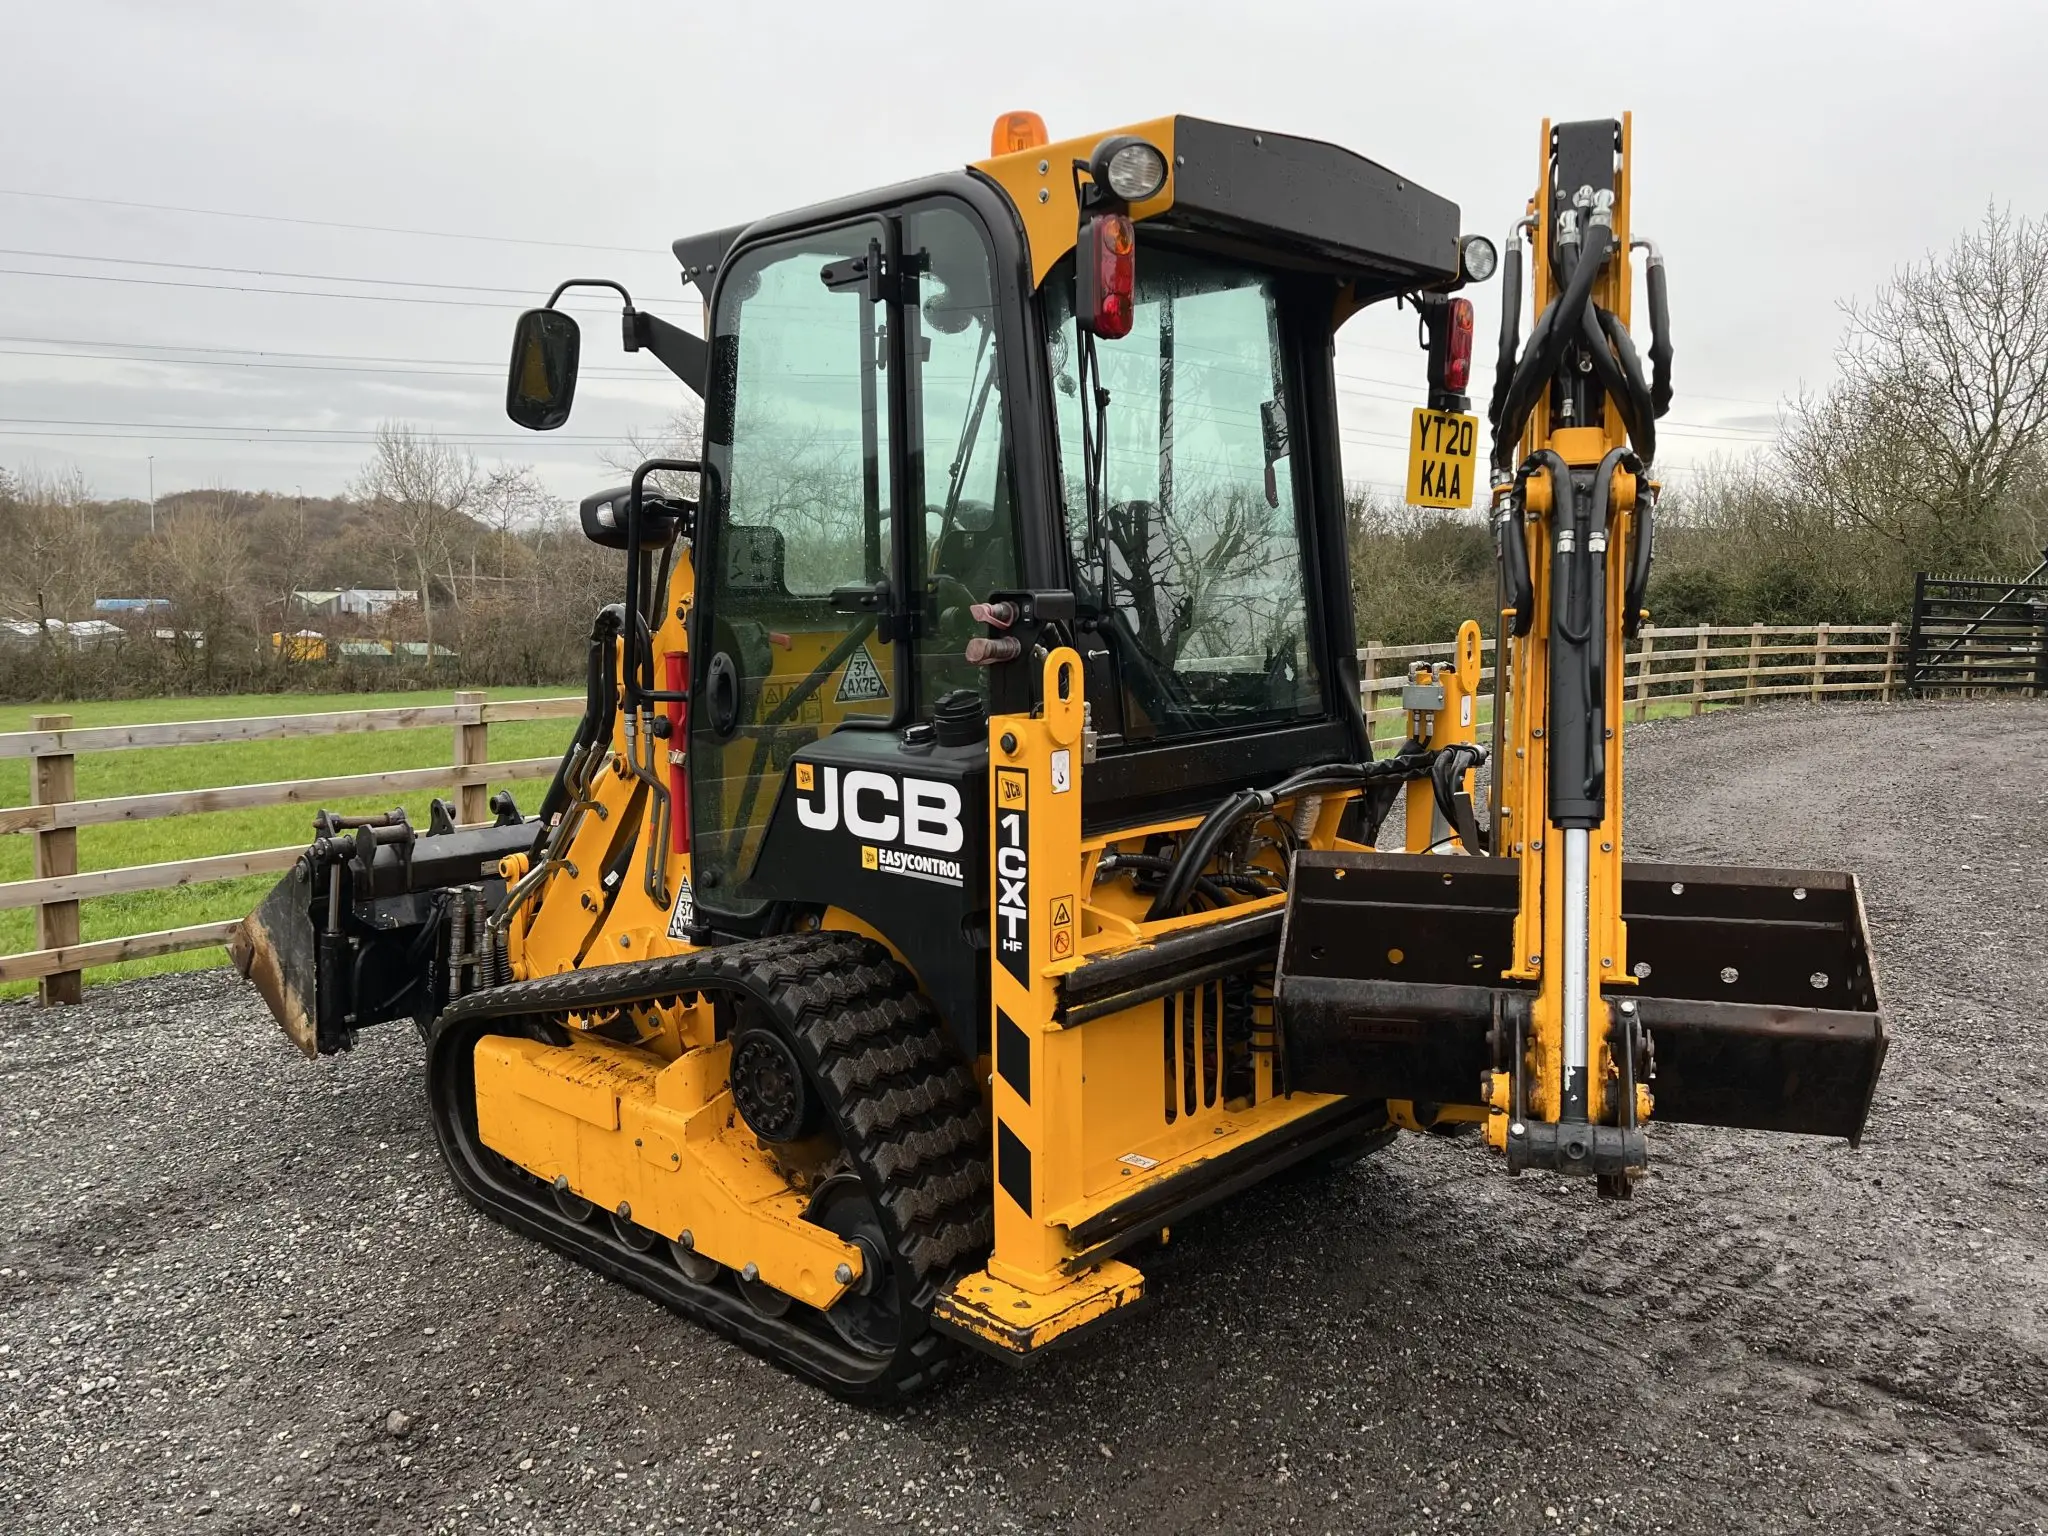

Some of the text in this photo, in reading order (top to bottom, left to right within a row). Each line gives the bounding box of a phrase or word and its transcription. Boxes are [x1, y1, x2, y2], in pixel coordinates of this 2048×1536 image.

[1419, 413, 1473, 457] YT20
[1420, 459, 1461, 500] KAA
[854, 661, 868, 677] 37
[848, 677, 877, 694] AX7E
[1005, 781, 1021, 799] JCB
[796, 767, 964, 853] JCB
[998, 813, 1027, 939] 1CXT
[681, 900, 693, 917] 37
[1002, 939, 1022, 953] HF
